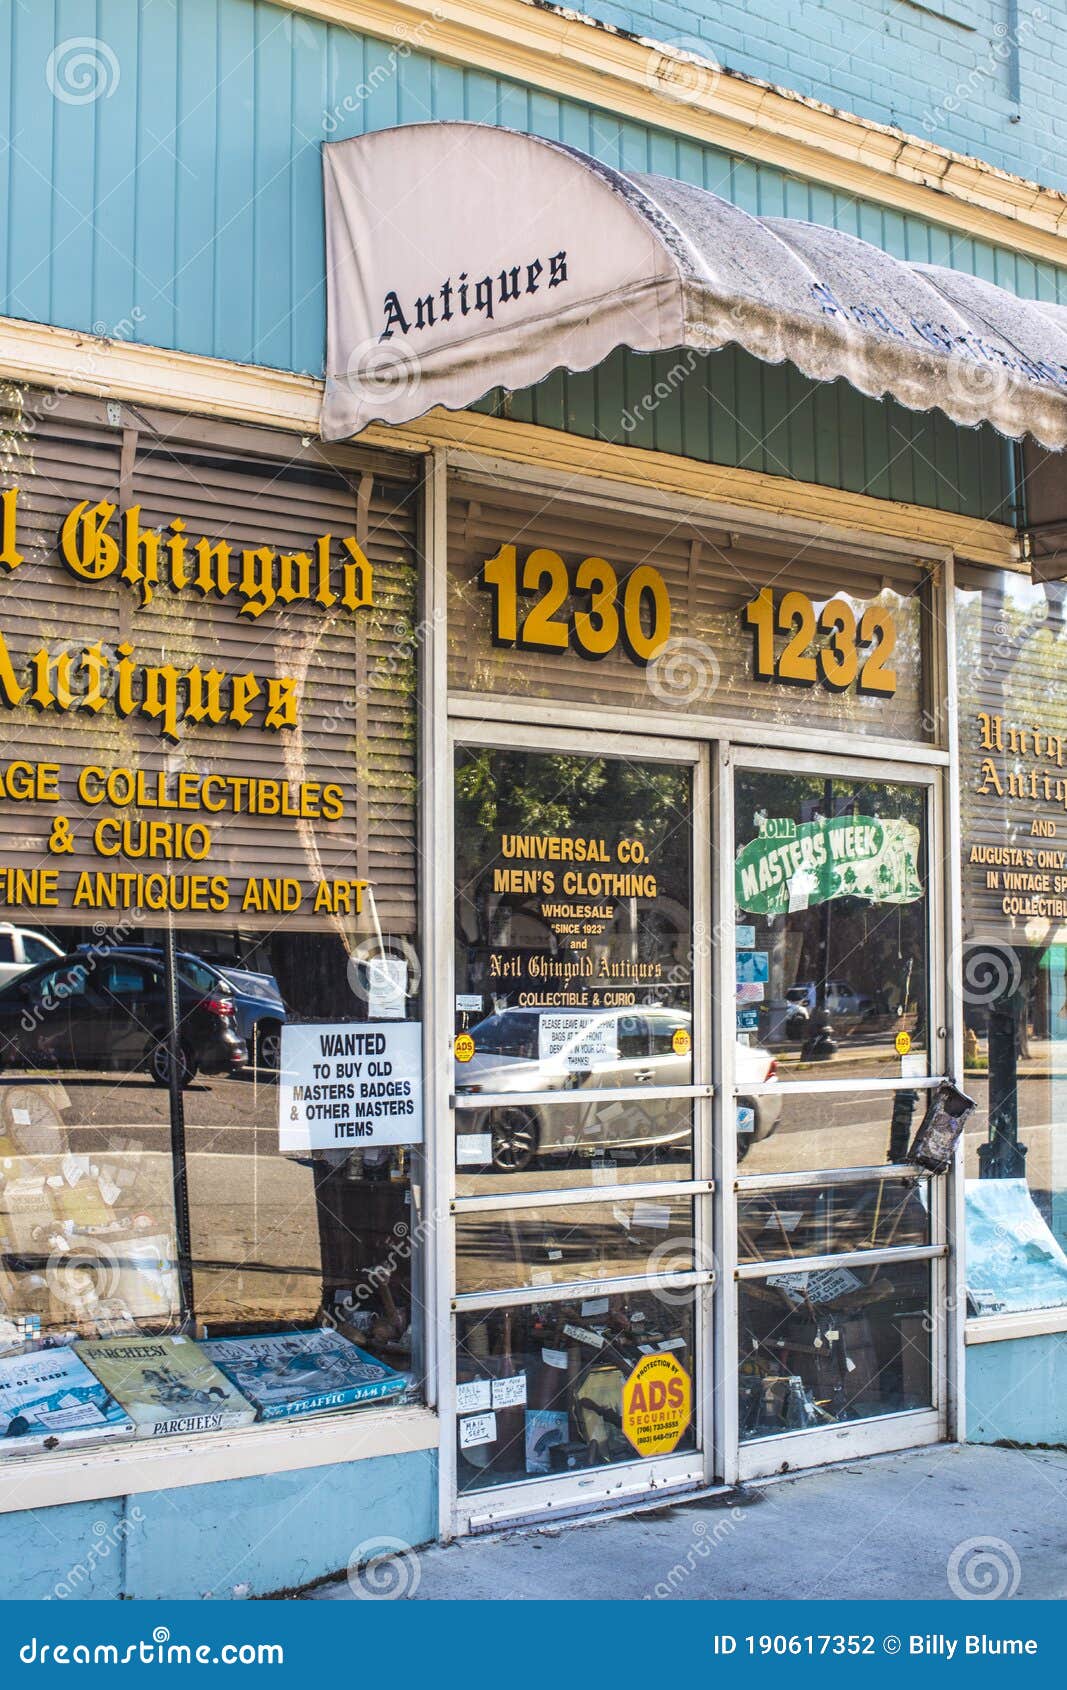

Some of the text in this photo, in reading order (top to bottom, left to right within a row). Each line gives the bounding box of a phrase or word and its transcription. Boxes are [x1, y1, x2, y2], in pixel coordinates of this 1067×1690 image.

[378, 250, 568, 343] Antiques
[58, 499, 375, 620] Ghingold
[478, 543, 671, 667] 1230
[744, 586, 897, 698] 1232
[0, 760, 345, 821] GE COLLECTIBLES
[48, 816, 212, 861] & CURIO
[1030, 819, 1057, 838] AND
[501, 835, 649, 864] UNIVERSAL CO.
[970, 845, 1066, 869] AUGUSTA'S ONLY
[741, 832, 827, 901] MASTERS
[828, 825, 877, 860] WEEK
[73, 871, 230, 913] ANTIQUES
[242, 876, 303, 913] AND
[313, 879, 368, 913] ART
[493, 869, 657, 898] MEN'S CLOTHING
[986, 871, 999, 889] IN
[1003, 872, 1050, 892] VINTAGE
[542, 904, 614, 919] WHOLESALE
[570, 938, 588, 950] and
[489, 954, 662, 989] Neil Ghingold Antiques
[519, 992, 635, 1007] COLLECTIBLE & CURIO
[320, 1033, 386, 1057] WANTED
[456, 1041, 473, 1052] ADS
[313, 1061, 393, 1080] TO BUY OLD
[293, 1081, 411, 1102] MASTERS BADGES
[290, 1100, 414, 1121] & OTHER MASTERS
[334, 1121, 373, 1138] ITEMS
[87, 1344, 168, 1360] PARCHEESI
[636, 1360, 670, 1380] PROTECTION
[290, 1393, 345, 1412] TRAFFIC
[629, 1376, 684, 1414] ADS
[153, 1414, 223, 1435] PARCHEESI
[629, 1409, 684, 1426] SECURITY
